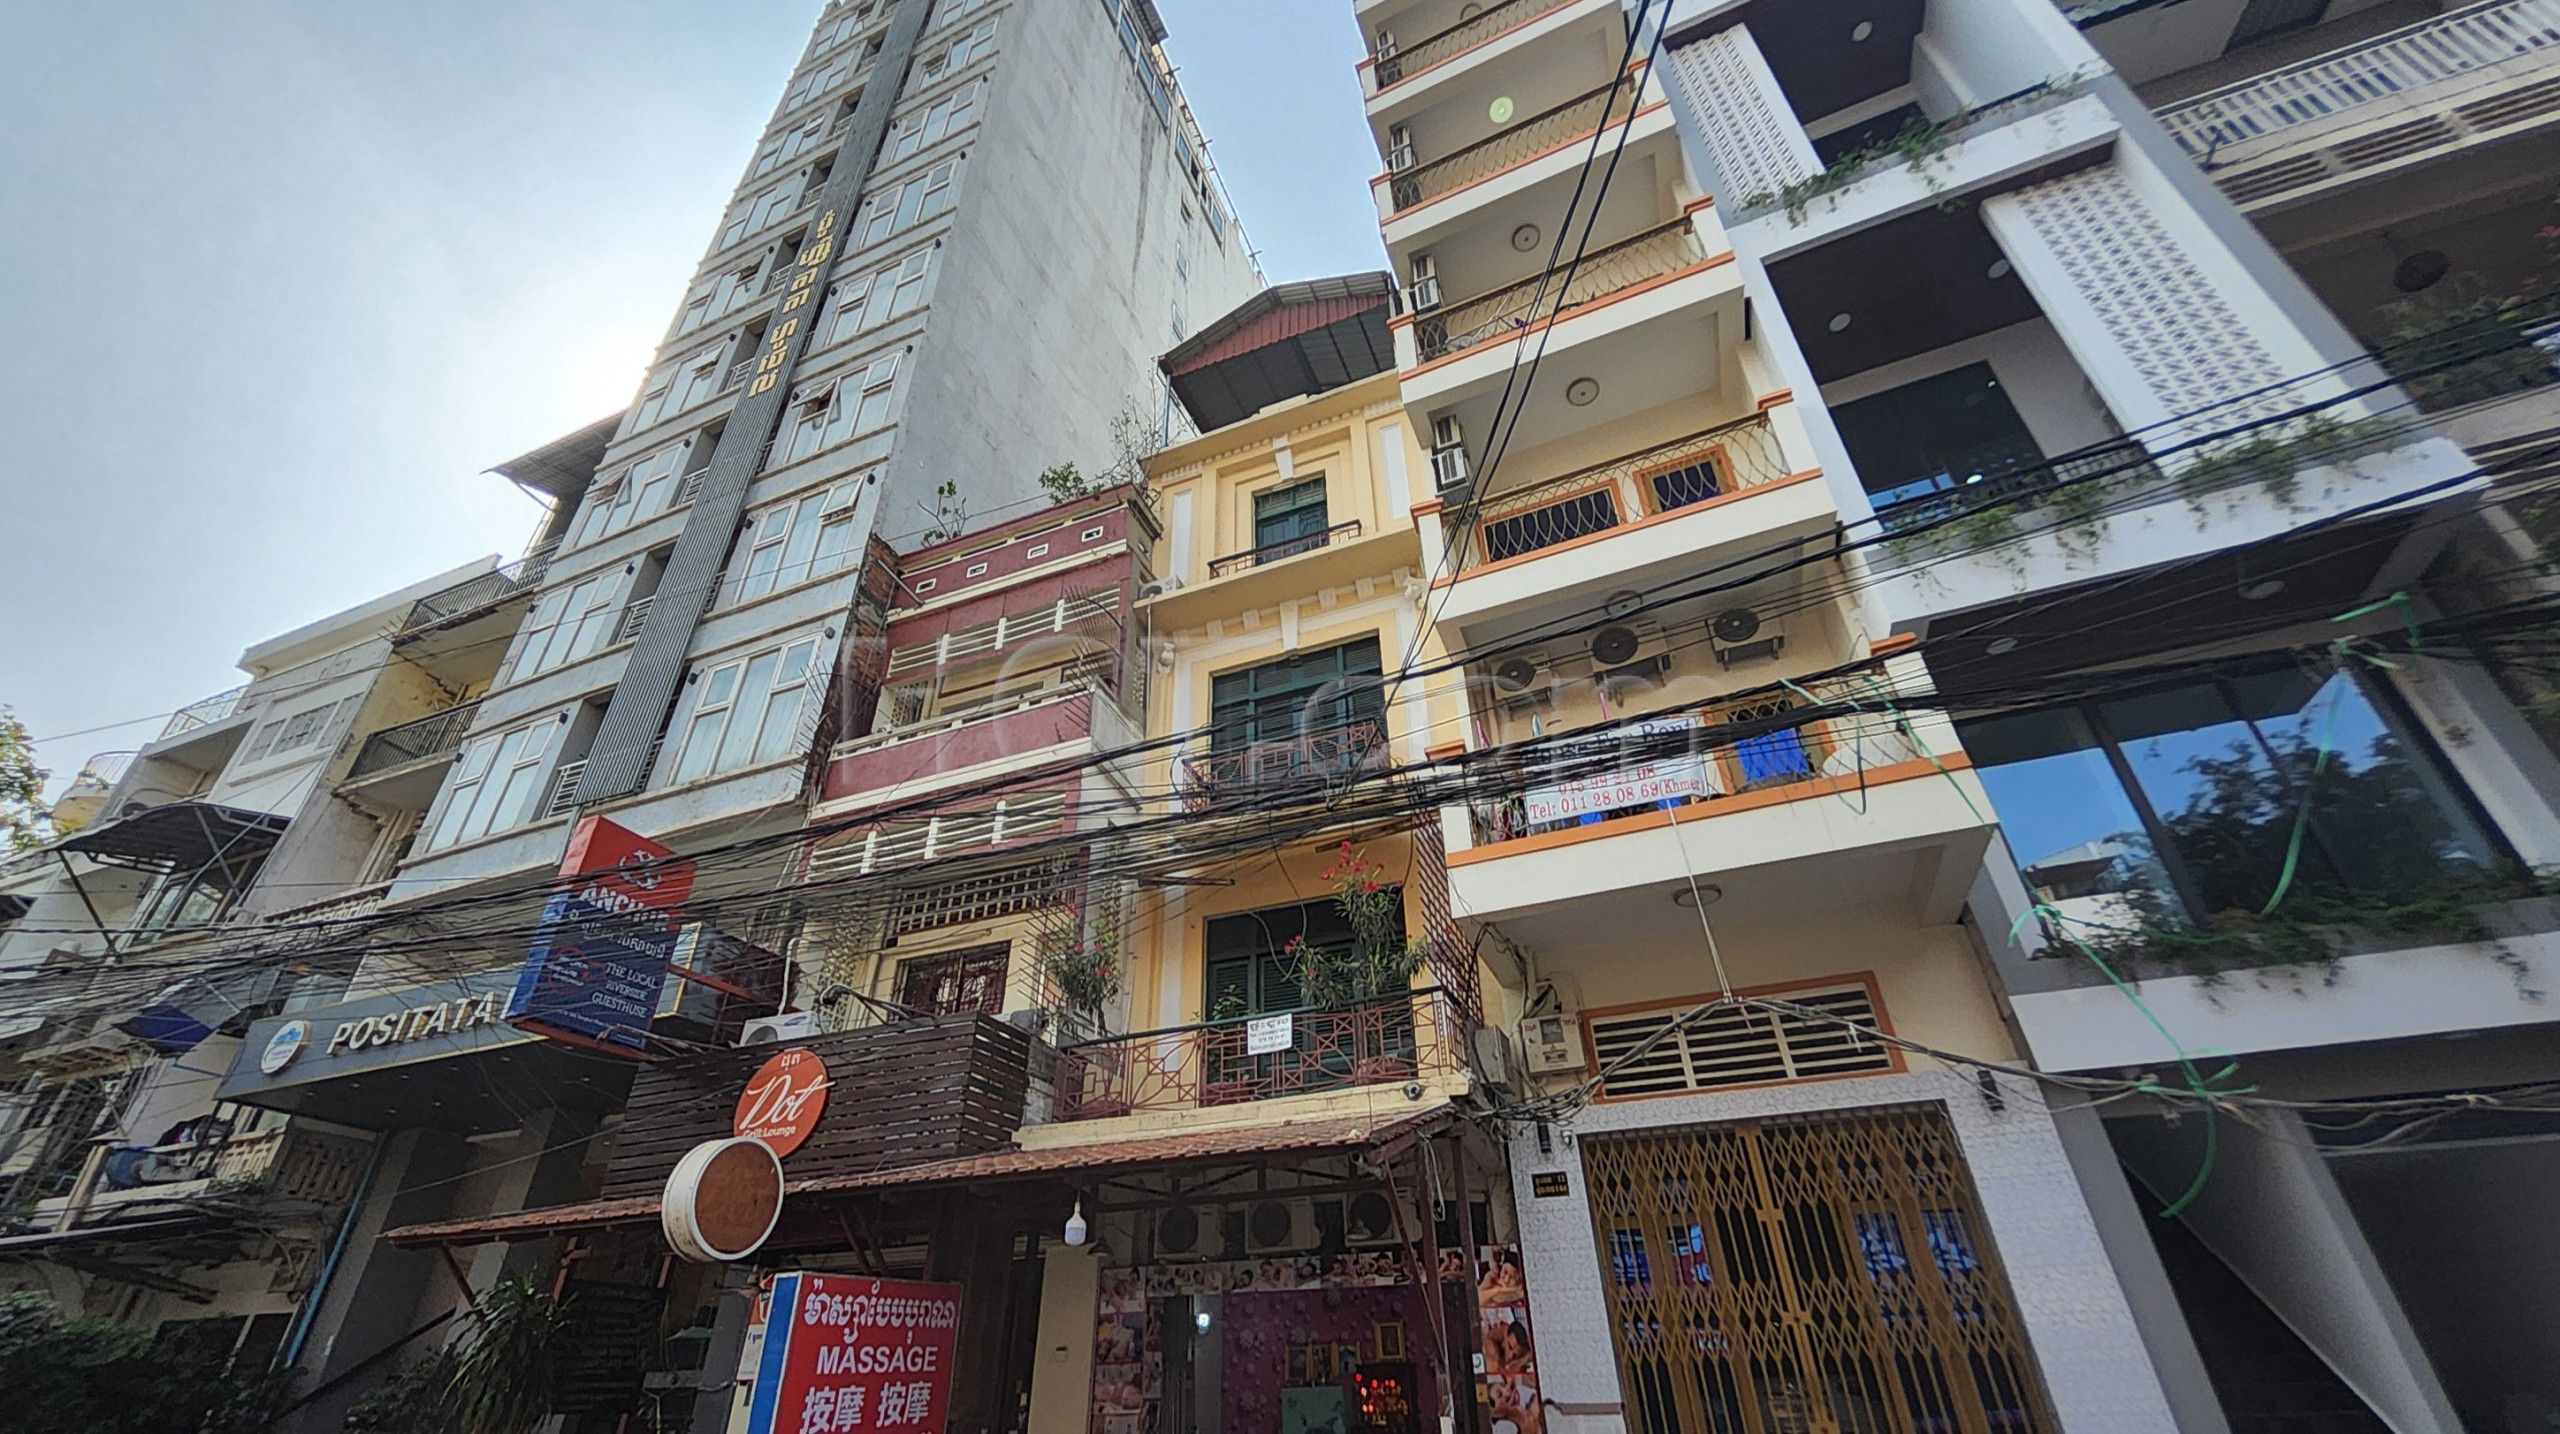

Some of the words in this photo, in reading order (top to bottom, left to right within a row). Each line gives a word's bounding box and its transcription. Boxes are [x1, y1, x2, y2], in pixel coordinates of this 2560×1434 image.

[1529, 802, 1557, 820] Tel:
[1561, 796, 1587, 813] 011
[1592, 792, 1612, 807] 28
[1616, 787, 1635, 804] 08
[605, 980, 648, 1002] RIVERSIDE
[606, 961, 625, 979] THE
[627, 969, 657, 990] LOCAL
[739, 1073, 836, 1130] Dot
[816, 1345, 939, 1376] MASSAGE
[799, 1384, 867, 1434] 按摩
[875, 1380, 933, 1428] 按摩
